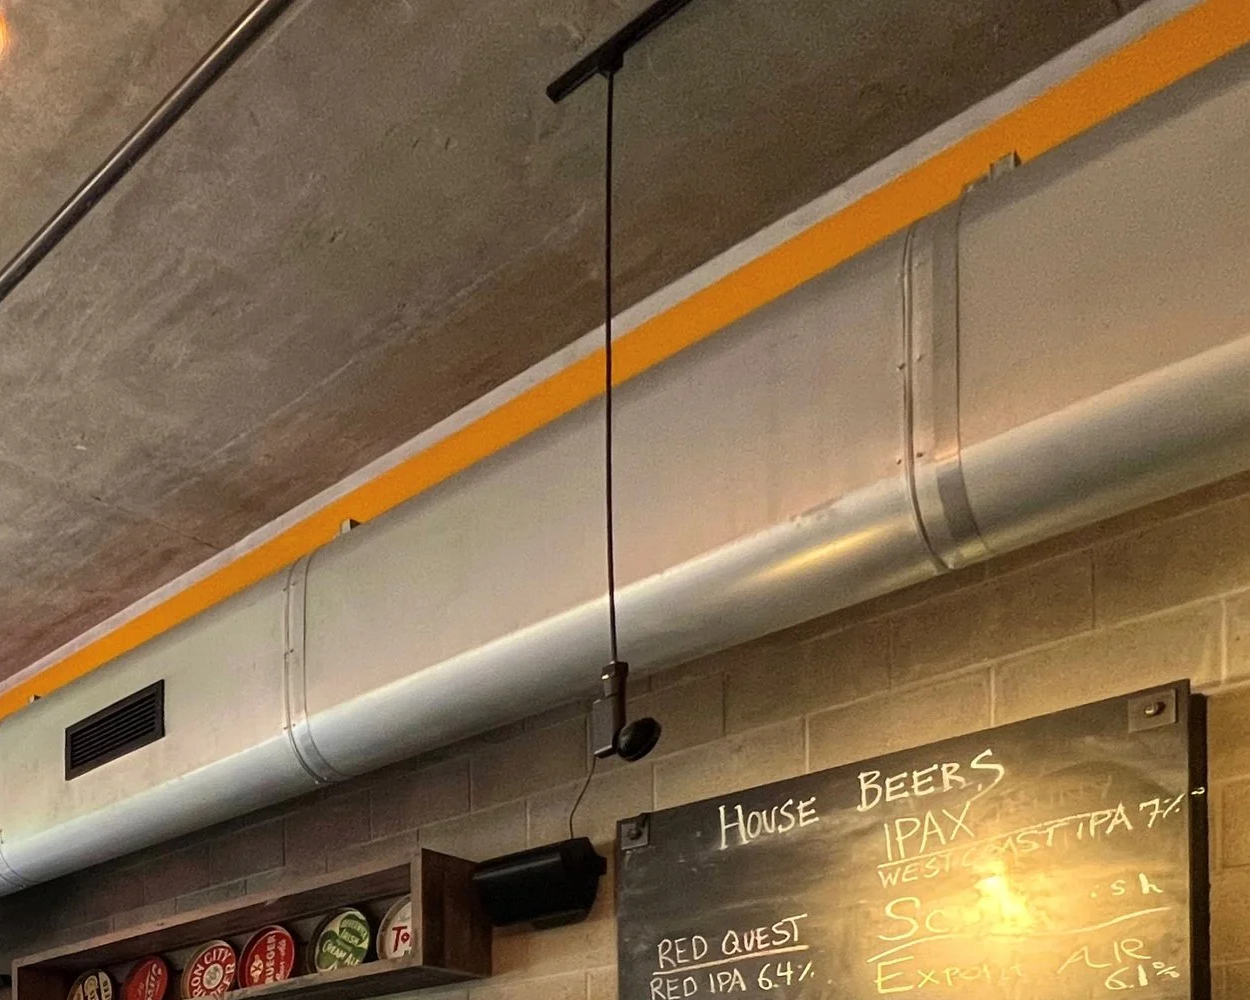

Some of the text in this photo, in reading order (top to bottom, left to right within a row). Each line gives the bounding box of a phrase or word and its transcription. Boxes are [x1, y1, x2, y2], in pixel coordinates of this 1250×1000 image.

[718, 749, 1005, 850] HOUSE BEERS
[878, 852, 951, 888] WEST
[1076, 803, 1133, 840] IPA
[883, 801, 974, 860] IPAX
[204, 948, 231, 964] CITY
[266, 934, 276, 984] RUEGER
[657, 914, 808, 969] RED QUEST
[650, 960, 815, 1000] RED IPA 6.4%
